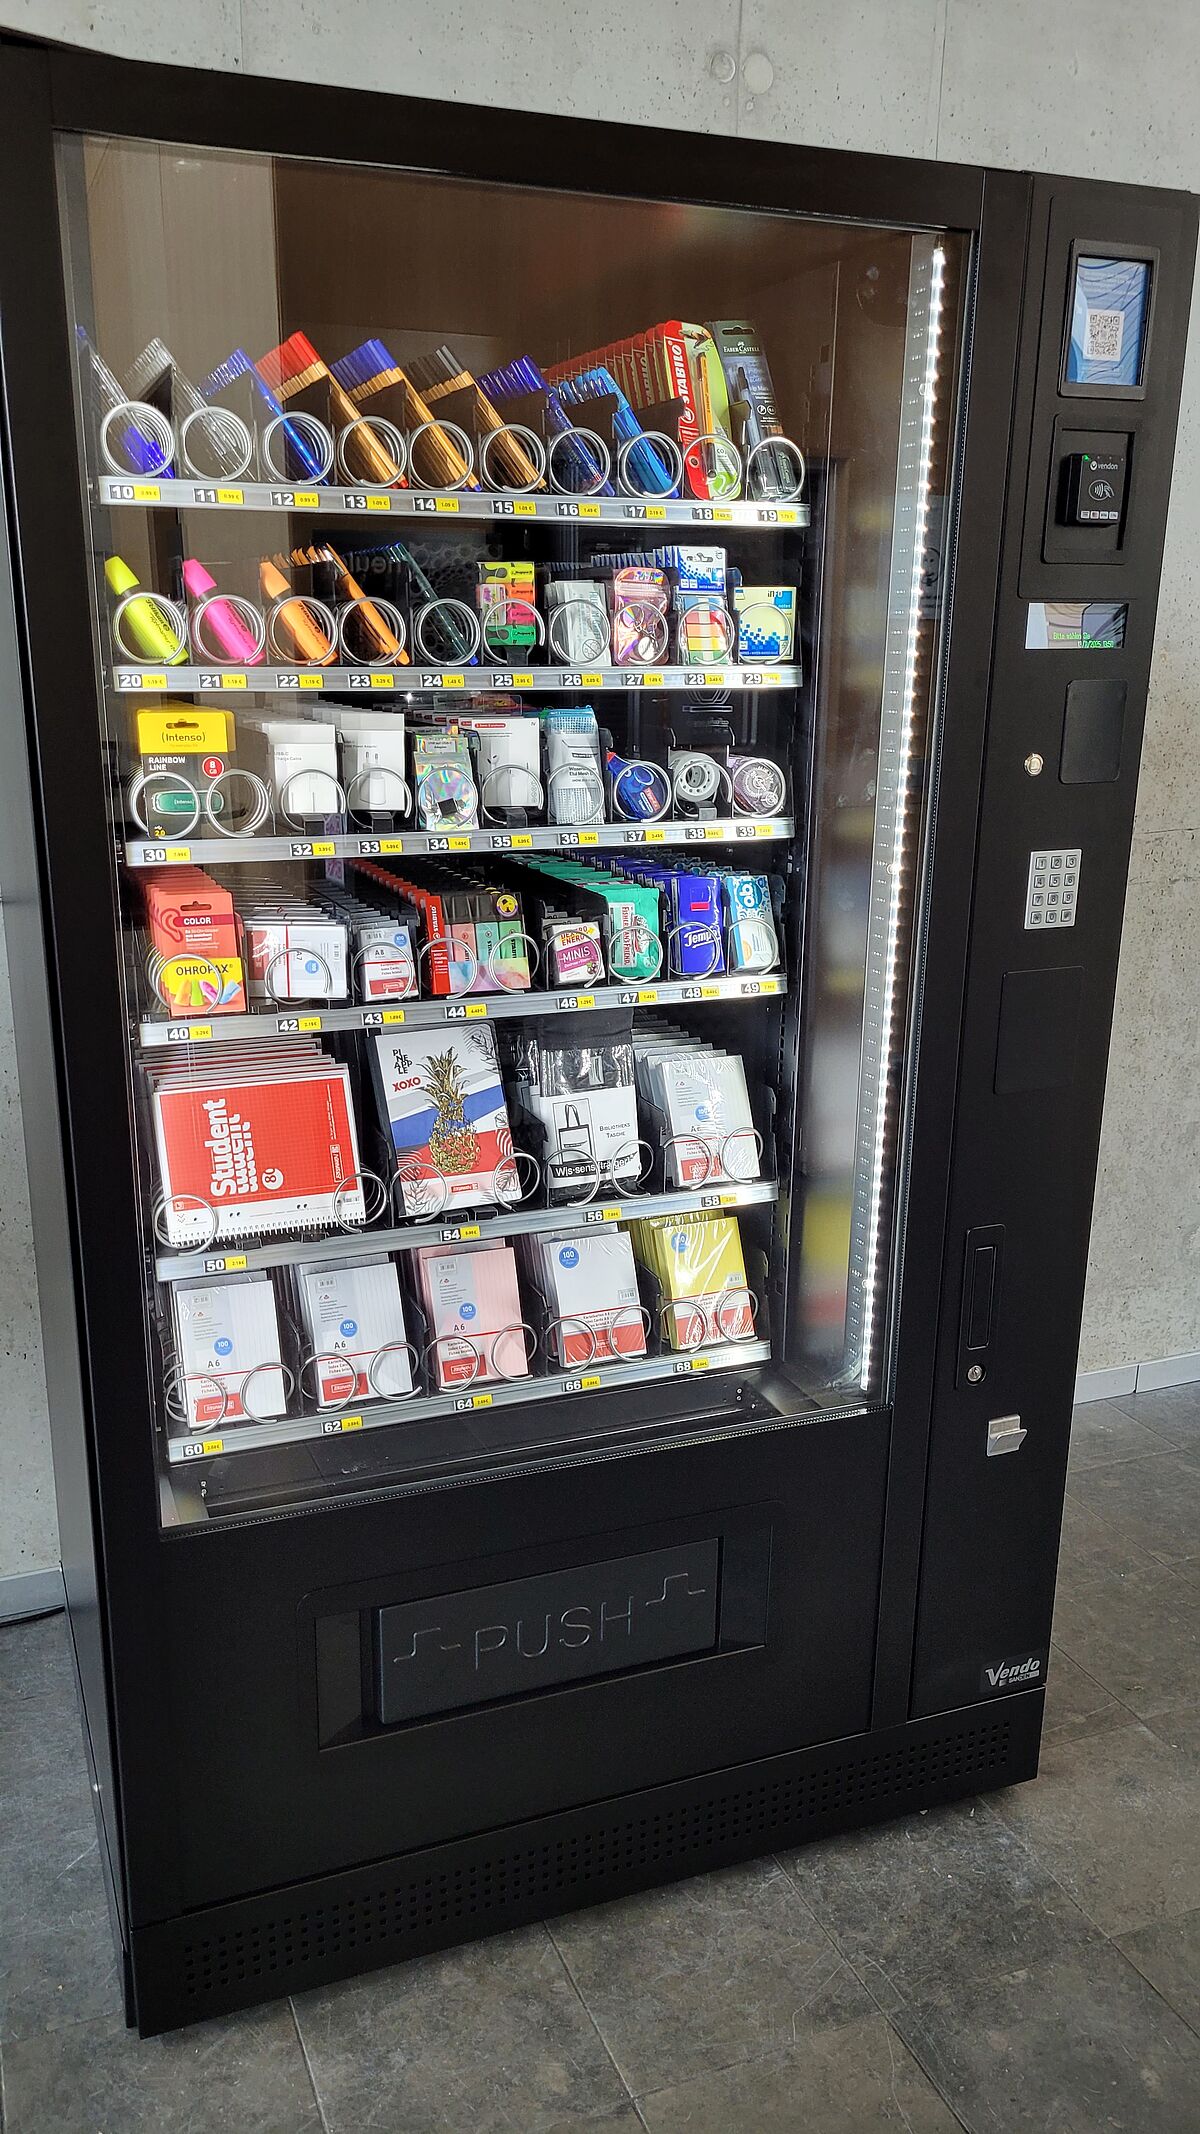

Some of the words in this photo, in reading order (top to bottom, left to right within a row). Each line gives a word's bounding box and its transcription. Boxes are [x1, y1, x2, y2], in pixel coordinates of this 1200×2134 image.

[1098, 463, 1118, 471] vendon
[112, 486, 133, 499] 10
[197, 489, 215, 502] 11
[273, 492, 294, 505] 12
[346, 496, 366, 508] 13
[416, 498, 435, 511] 14
[495, 502, 513, 514] 15
[560, 504, 578, 516] 16
[628, 506, 645, 518] 17
[696, 509, 713, 520] 18
[761, 510, 777, 521] 19
[120, 674, 142, 688] 20
[201, 674, 220, 688] 21
[278, 675, 299, 688] 22
[350, 675, 370, 687] 23
[423, 675, 442, 687] 24
[494, 674, 513, 686] 25
[564, 674, 582, 686] 26
[626, 674, 643, 686] 27
[688, 674, 705, 685] 28
[745, 674, 762, 685] 29
[161, 731, 206, 744] (Intenso)
[148, 756, 186, 764] RAINBOW
[149, 763, 168, 771] LINE
[628, 830, 645, 841] 37
[688, 828, 705, 839] 38
[739, 826, 755, 837] 39
[430, 838, 448, 850] 34
[493, 836, 511, 847] 35
[561, 833, 578, 845] 36
[293, 844, 312, 856] 32
[360, 841, 380, 853] 33
[144, 849, 166, 862] 30
[183, 917, 212, 926] COLOR
[563, 946, 591, 962] MINIS
[685, 987, 701, 998] 48
[744, 983, 760, 993] 49
[560, 997, 577, 1008] 46
[621, 992, 638, 1004] 47
[446, 1005, 465, 1018] 44
[363, 1012, 383, 1024] 43
[279, 1019, 298, 1031] 42
[169, 1027, 189, 1040] 40
[392, 1048, 402, 1056] PI
[396, 1054, 409, 1062] NE
[394, 1060, 413, 1069] APP
[397, 1067, 409, 1075] LE
[392, 1076, 421, 1092] XOXO
[202, 1098, 237, 1197] Student
[705, 1195, 720, 1206] 58
[587, 1210, 603, 1221] 56
[443, 1229, 460, 1241] 54
[562, 1250, 575, 1259] 100
[206, 1258, 225, 1271] 50
[342, 1322, 354, 1330] 100
[217, 1340, 229, 1348] 100
[676, 1361, 691, 1372] 68
[565, 1379, 581, 1391] 66
[456, 1398, 473, 1410] 64
[324, 1420, 341, 1432] 62
[185, 1443, 203, 1456] 60
[474, 1595, 635, 1671] PUSH
[985, 1657, 1040, 1686] Vendo
